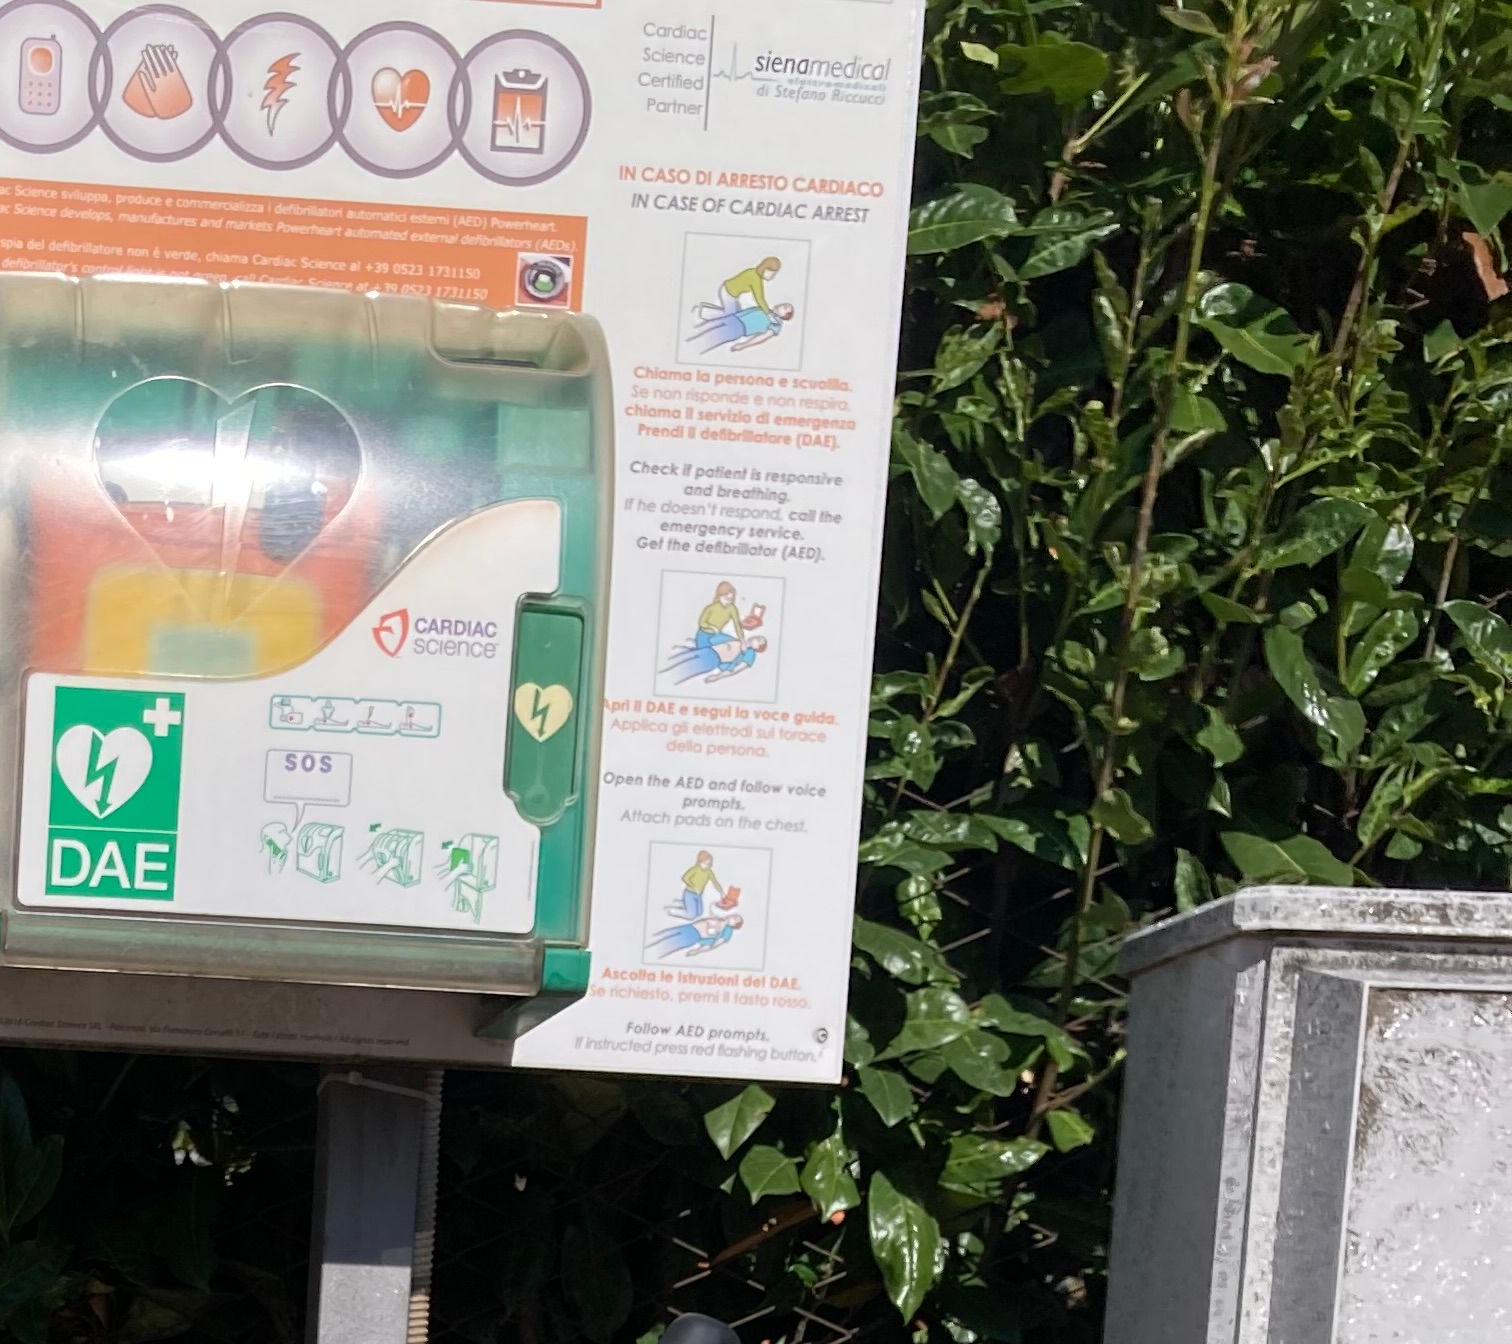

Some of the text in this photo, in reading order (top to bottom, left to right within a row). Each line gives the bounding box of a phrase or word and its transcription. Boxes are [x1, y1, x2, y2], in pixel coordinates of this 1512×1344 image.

[643, 22, 708, 42] Cardiac
[642, 47, 706, 66] Science
[754, 50, 892, 82] sienamedical
[638, 72, 704, 91] Certified
[756, 85, 769, 97] di
[774, 84, 826, 103] Stefano
[646, 97, 703, 116] Partner
[618, 164, 885, 198] IN CASO DI ARRESTO CARDIACO
[14, 184, 59, 200] Science
[115, 193, 163, 207] produce
[273, 202, 344, 218] defibrillatori
[452, 215, 488, 230] (AED)
[630, 192, 870, 223] IN CASE OF CARDIAC ARREST
[0, 238, 24, 251] spia
[26, 238, 46, 251] del
[47, 239, 124, 257] defibrillatore
[126, 247, 150, 257] non
[163, 250, 201, 263] verde,
[205, 251, 249, 265] chiama
[251, 253, 297, 268] Cardiac
[300, 256, 348, 272] Science
[365, 261, 390, 274] +39
[392, 262, 424, 276] 0523
[428, 265, 481, 280] 1731150
[633, 365, 693, 382] Chiama
[695, 369, 711, 384] la
[713, 373, 775, 388] persona
[624, 403, 682, 420] chiama
[697, 408, 753, 424] servizio
[754, 411, 771, 425] di
[773, 415, 857, 432] emergenza
[637, 422, 685, 439] Prendi
[699, 426, 792, 446] defibrillatore
[629, 460, 679, 477] Check
[694, 465, 748, 481] patient
[764, 471, 844, 487] responsive
[683, 483, 791, 505] and breathing.
[636, 498, 657, 513] he
[787, 509, 817, 523] call
[818, 509, 843, 524] the
[659, 521, 805, 541] emergency service.
[636, 535, 664, 550] Get
[666, 537, 691, 553] the
[694, 539, 778, 558] defibrillator
[414, 617, 498, 638] CARDIAC
[645, 700, 676, 716] DAE
[692, 705, 733, 721] segui
[734, 705, 750, 720] la
[753, 711, 790, 722] voce
[665, 738, 703, 754] della
[602, 771, 827, 798] Open the AED and follow voice
[619, 809, 671, 825] Attach
[673, 813, 712, 828] pads
[714, 816, 735, 829] on
[737, 815, 762, 831] the
[50, 839, 171, 891] DAE
[625, 1021, 672, 1036] Follow
[675, 1024, 705, 1038] AED
